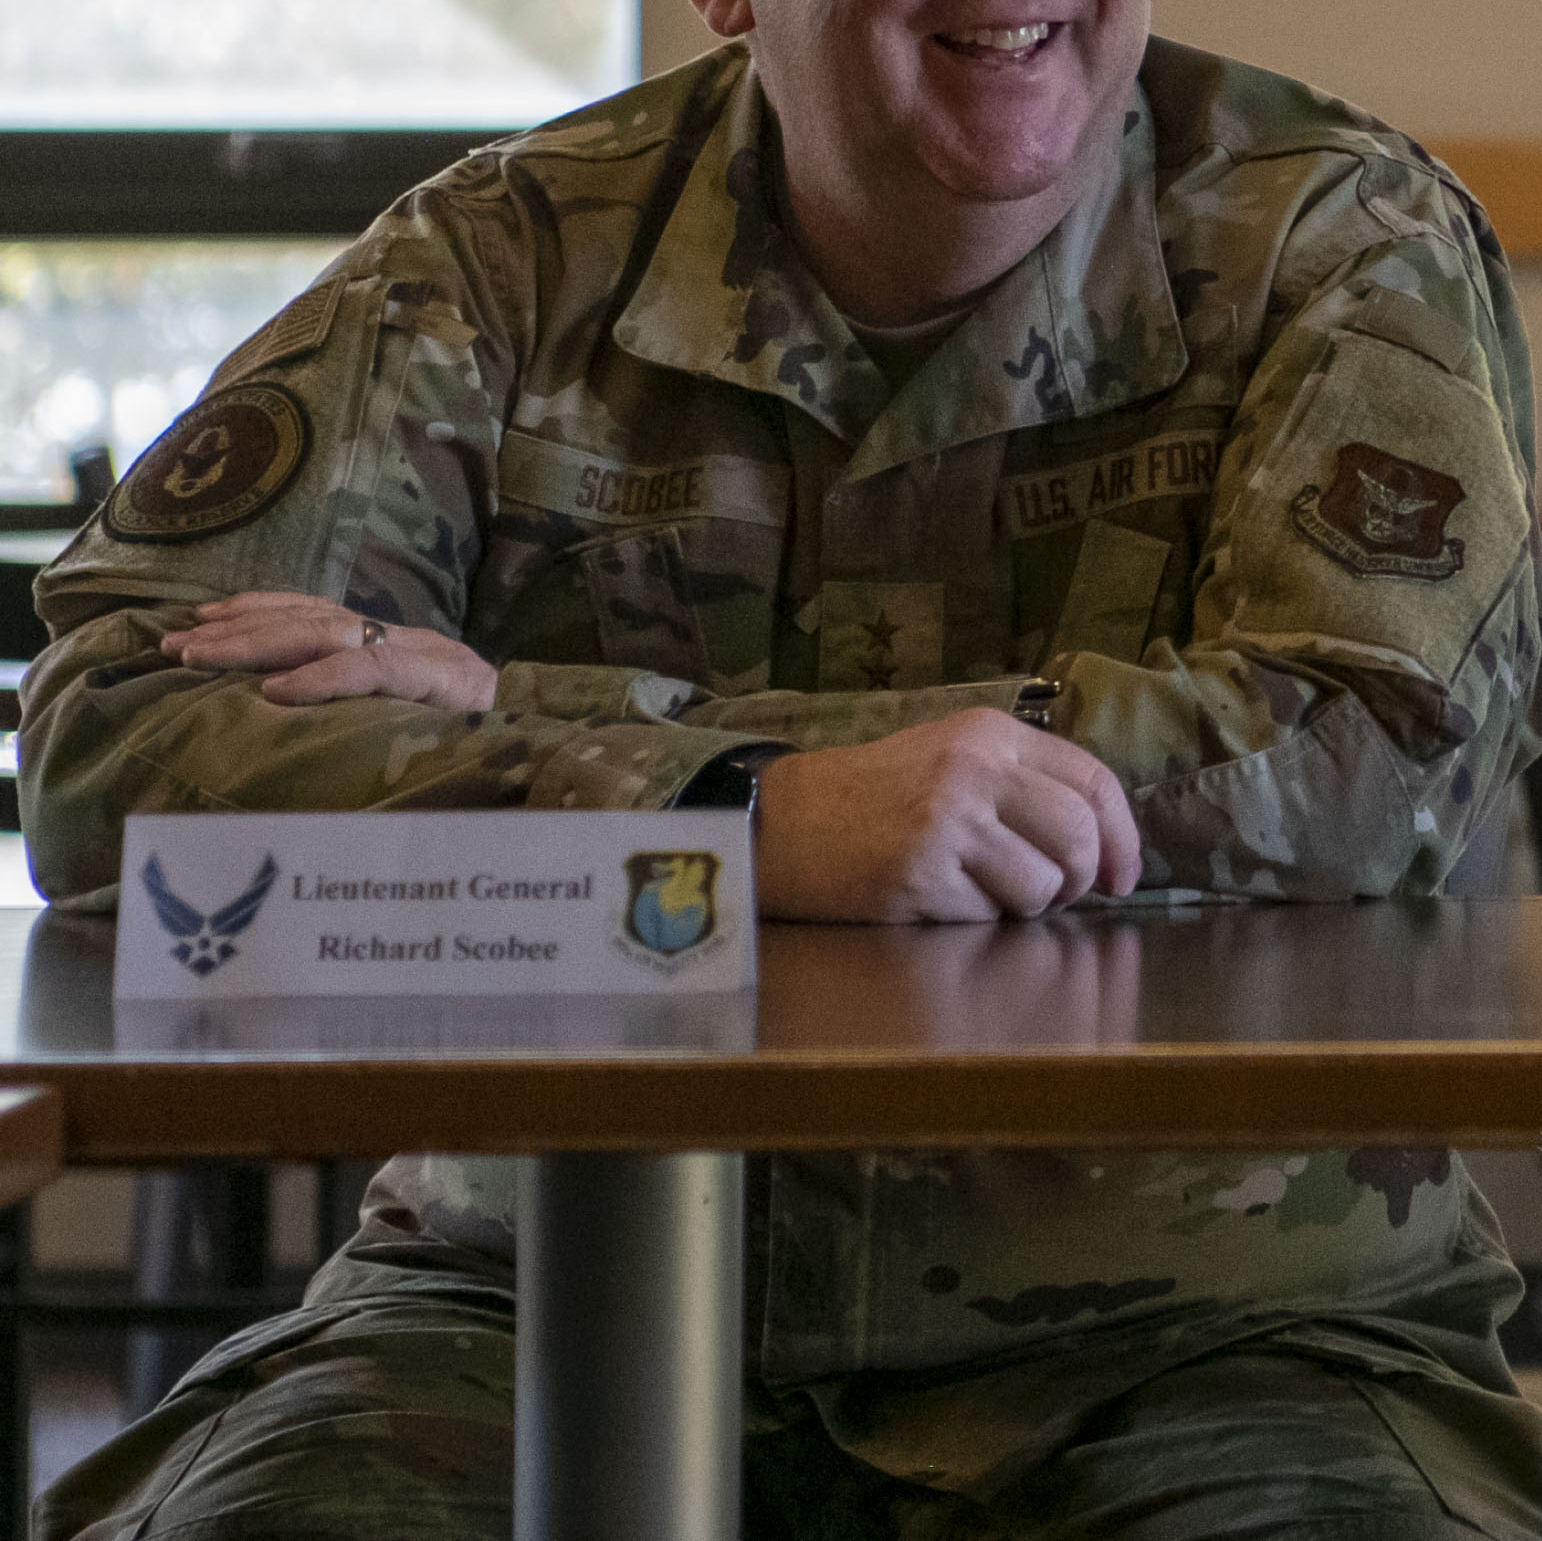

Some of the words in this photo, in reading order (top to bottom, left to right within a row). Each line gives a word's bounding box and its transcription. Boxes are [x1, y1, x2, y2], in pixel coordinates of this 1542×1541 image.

[574, 464, 705, 517] SCOBEE
[1015, 476, 1076, 528] U.S.
[1089, 453, 1135, 508] AIR
[1147, 439, 1224, 491] FOR
[291, 875, 459, 903] Lieutenant
[468, 874, 593, 903] General
[316, 934, 442, 962] Richard
[452, 934, 559, 962] Scobee
